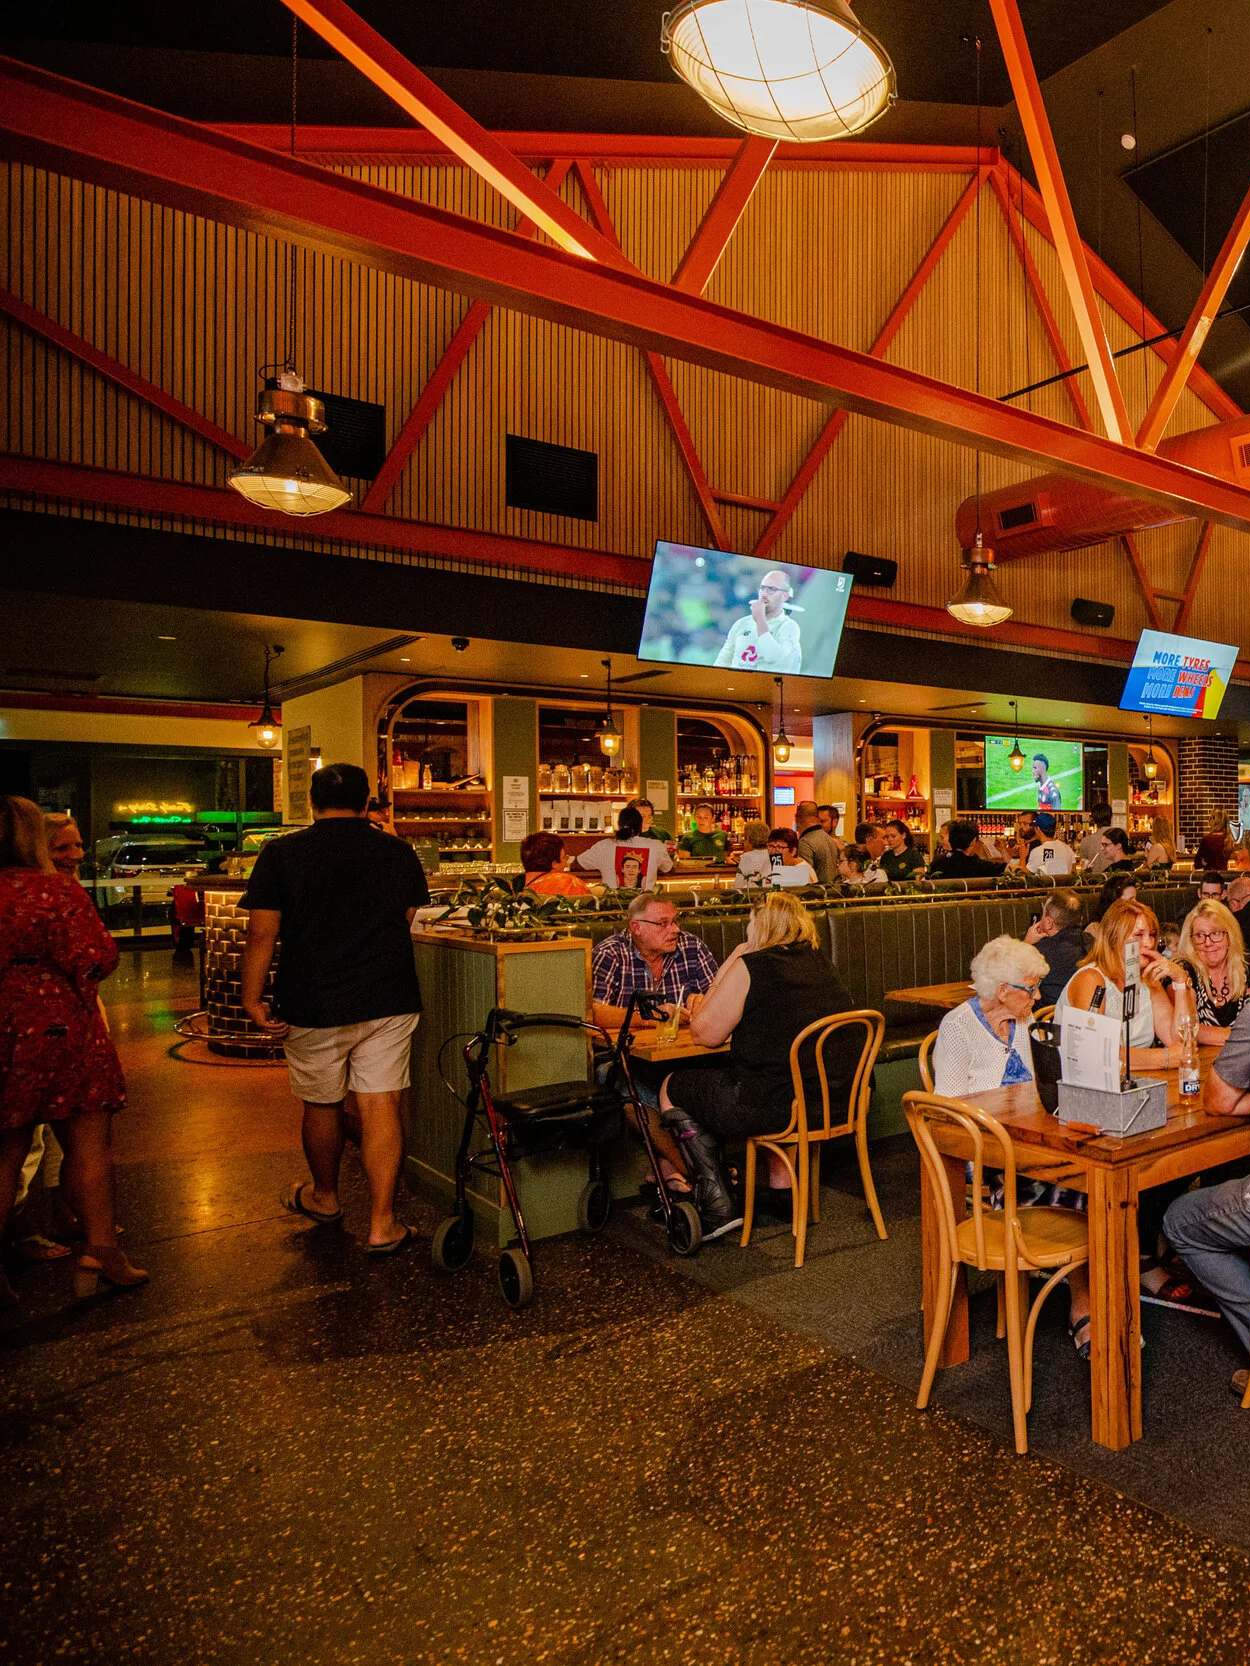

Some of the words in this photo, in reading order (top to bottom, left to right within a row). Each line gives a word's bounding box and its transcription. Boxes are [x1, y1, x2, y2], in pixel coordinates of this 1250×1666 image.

[1153, 651, 1181, 666] MORE
[1182, 656, 1211, 672] TYRES
[1147, 666, 1178, 683] MORE
[1177, 671, 1214, 688] WHEELS
[1141, 682, 1174, 699] MORE
[771, 855, 782, 866] 25
[1125, 989, 1133, 1016] 10
